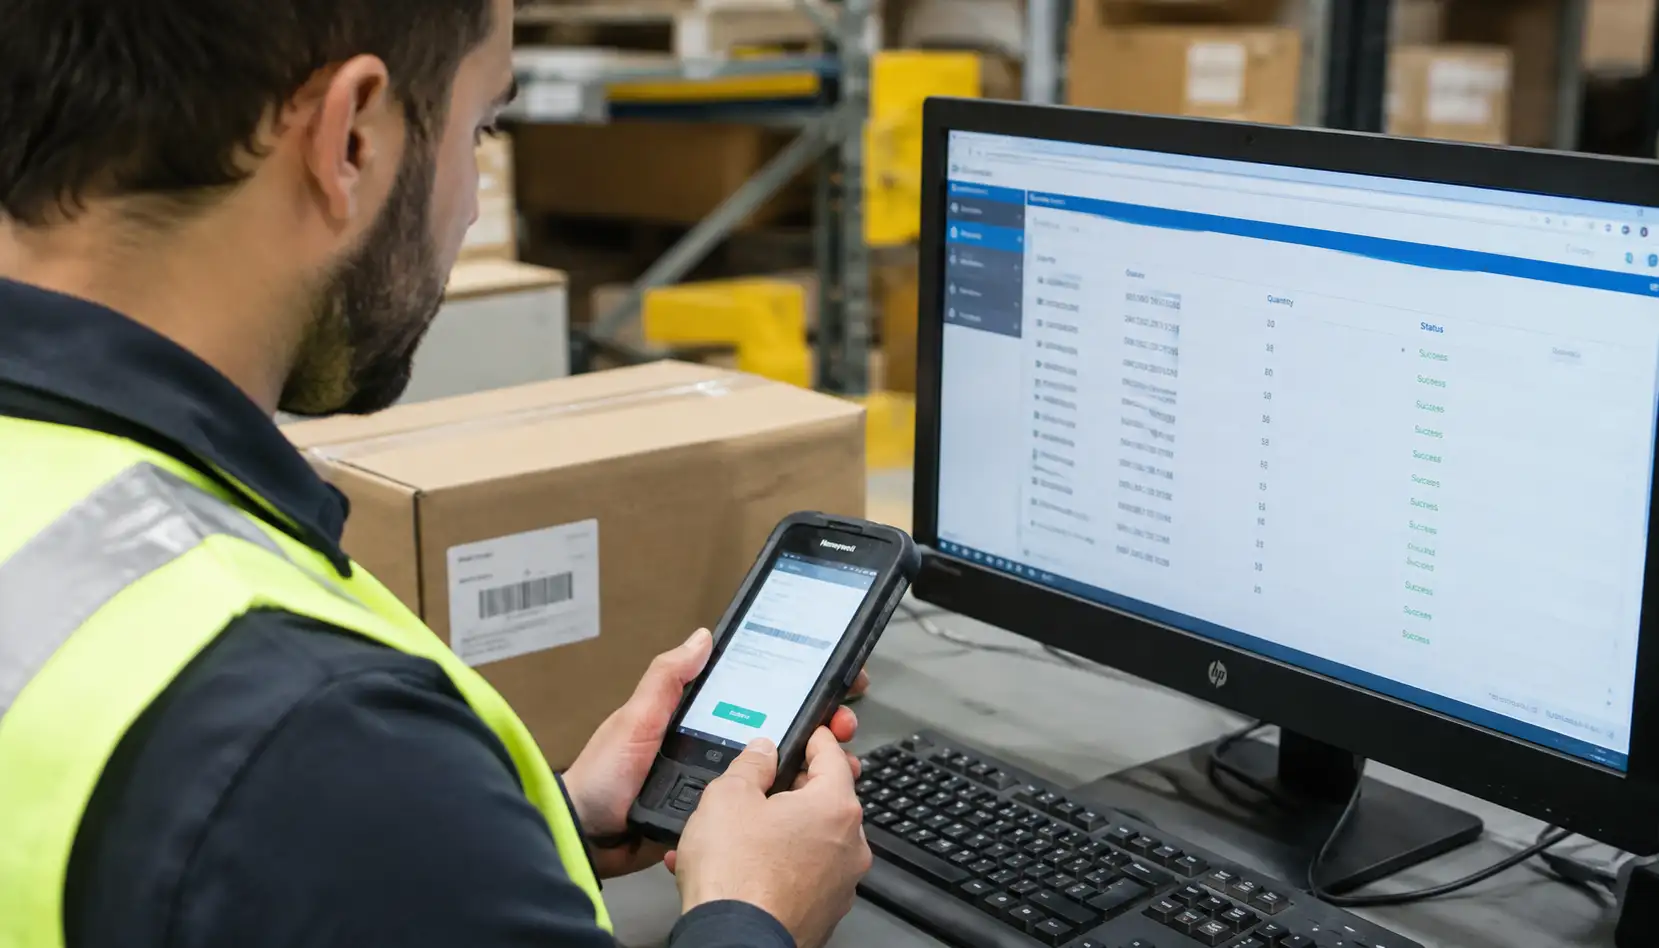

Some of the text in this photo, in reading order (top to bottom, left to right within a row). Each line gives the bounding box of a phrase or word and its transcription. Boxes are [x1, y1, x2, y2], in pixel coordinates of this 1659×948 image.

[1266, 294, 1294, 308] Quantity
[1420, 321, 1445, 334] Status
[1418, 348, 1449, 362] Success
[1416, 374, 1447, 389] Success
[1415, 399, 1445, 414] Success
[1414, 424, 1443, 439] Success
[1412, 449, 1442, 464] Success
[1410, 497, 1439, 512] Success
[1408, 520, 1437, 535] Success
[820, 539, 857, 553] Honeywell
[1404, 580, 1434, 596] Success
[1209, 660, 1226, 688] hp
